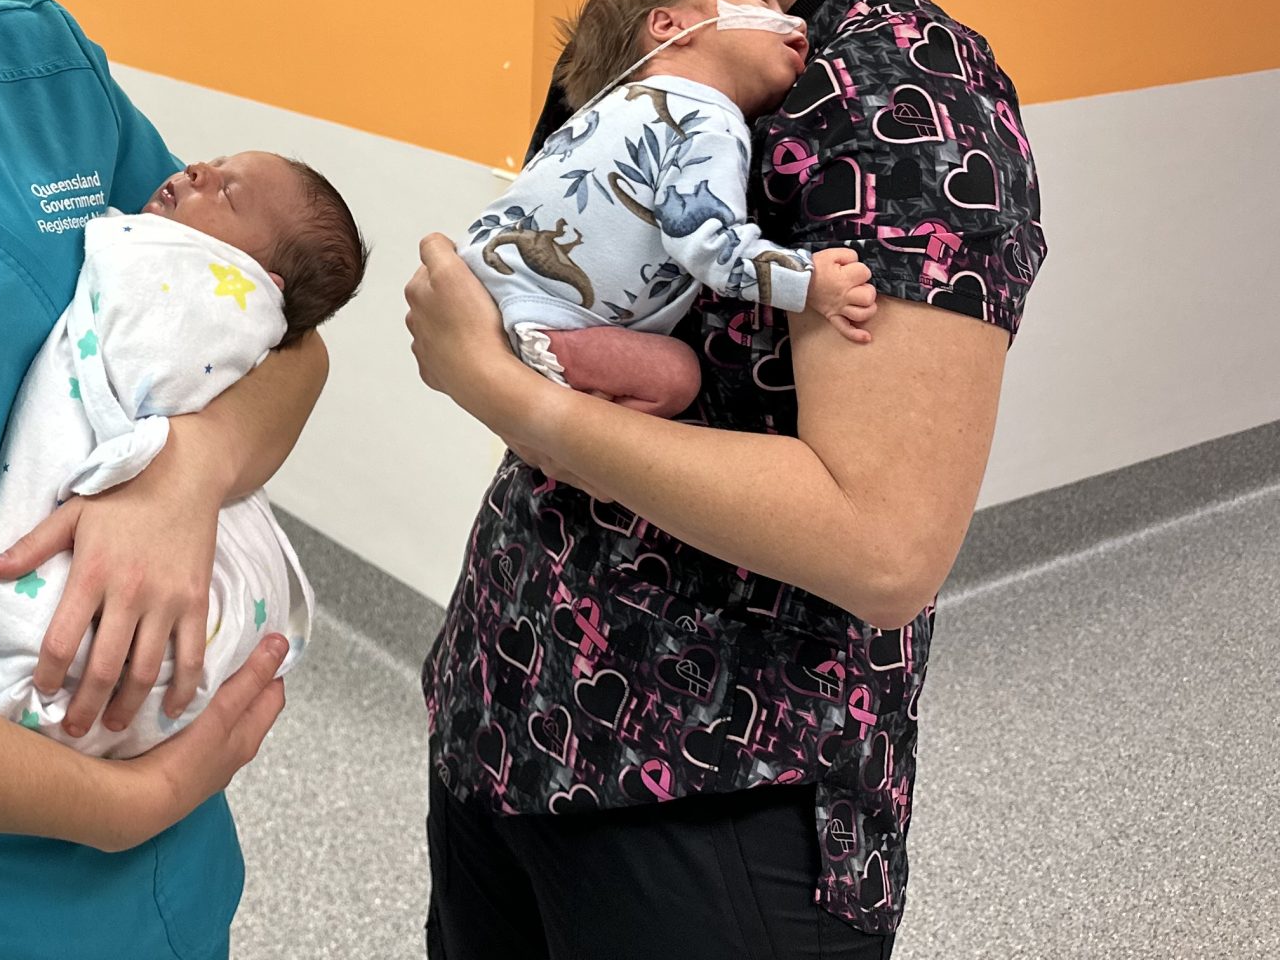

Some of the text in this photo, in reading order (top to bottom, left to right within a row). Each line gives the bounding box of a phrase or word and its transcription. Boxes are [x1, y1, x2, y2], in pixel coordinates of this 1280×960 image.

[31, 171, 101, 198] Queensland
[40, 191, 105, 213] Government
[37, 214, 89, 234] Registered
